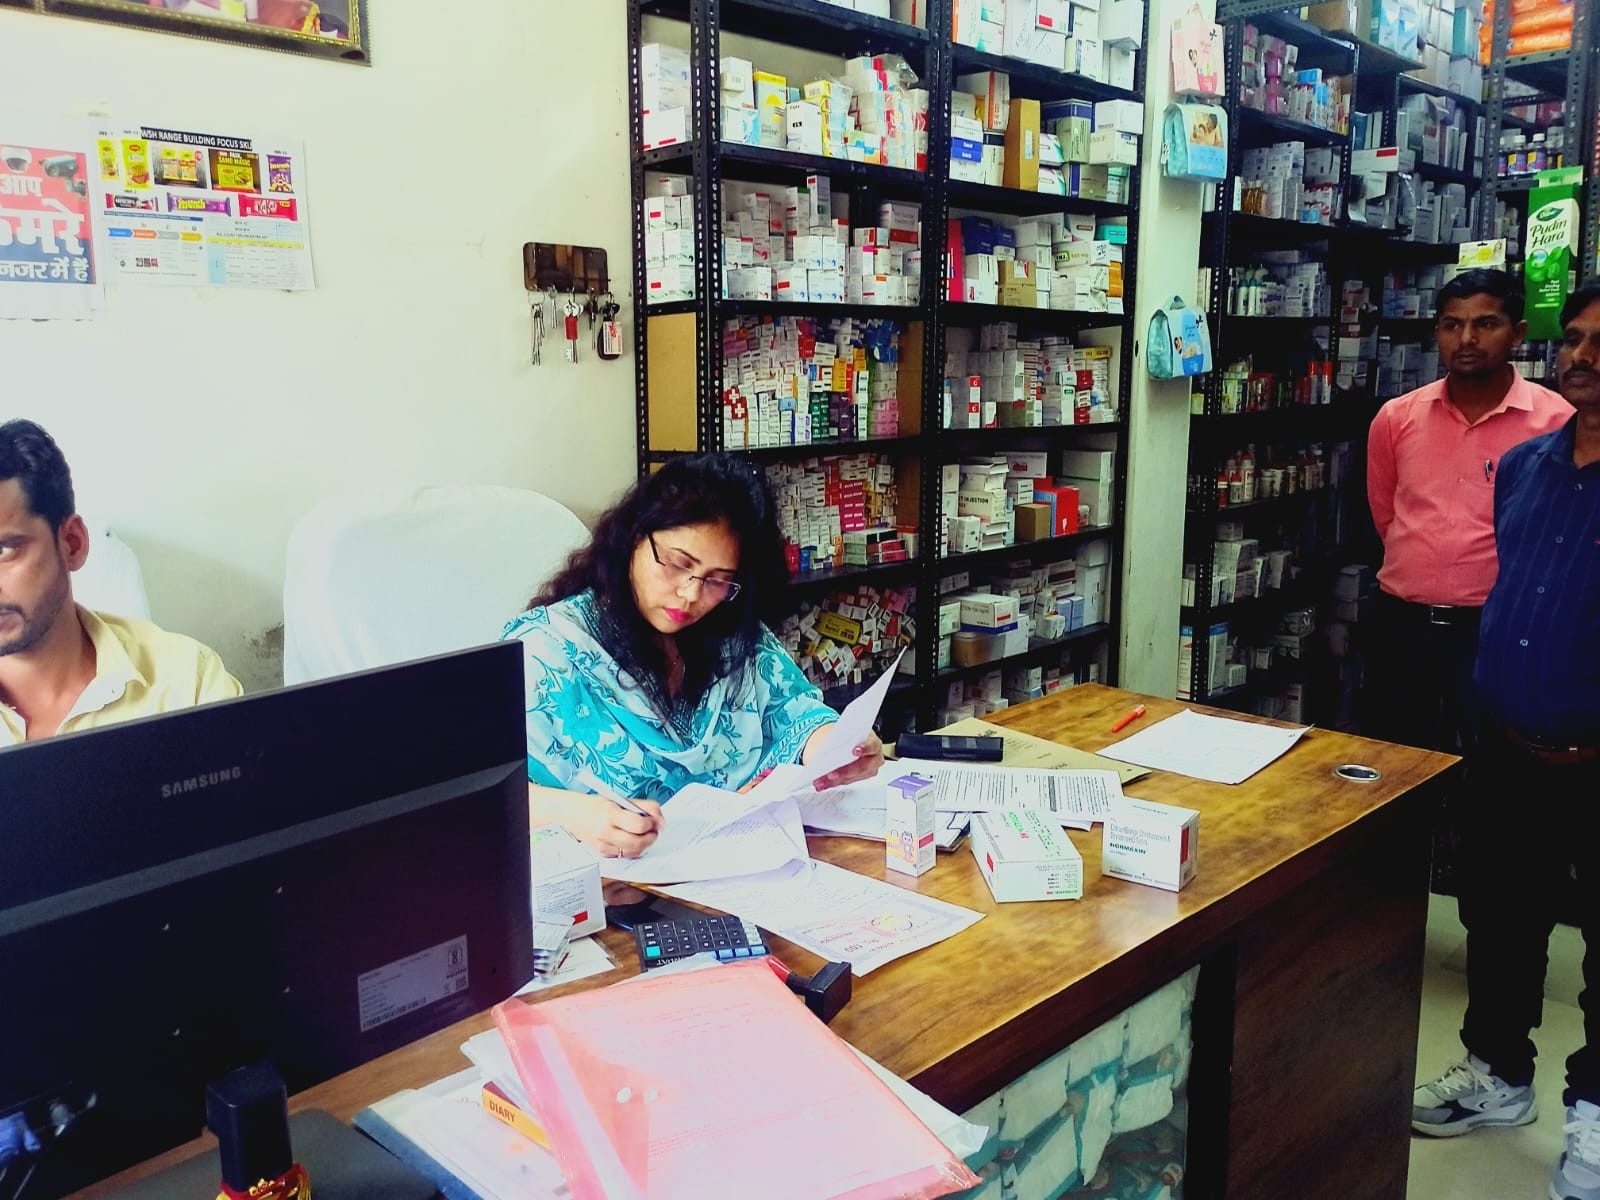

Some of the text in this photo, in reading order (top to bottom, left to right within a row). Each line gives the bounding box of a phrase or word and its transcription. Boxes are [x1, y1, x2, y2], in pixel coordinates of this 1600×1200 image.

[159, 131, 182, 143] RANGE
[184, 134, 216, 147] BUILDING
[217, 138, 239, 149] FOCUS
[0, 175, 43, 197] आप
[1530, 218, 1567, 238] Pudin
[1532, 231, 1565, 248] Hara
[50, 256, 71, 281] में
[964, 496, 989, 504] INJECTION
[161, 766, 241, 798] SAMSUNG
[489, 1099, 516, 1122] DIARY
